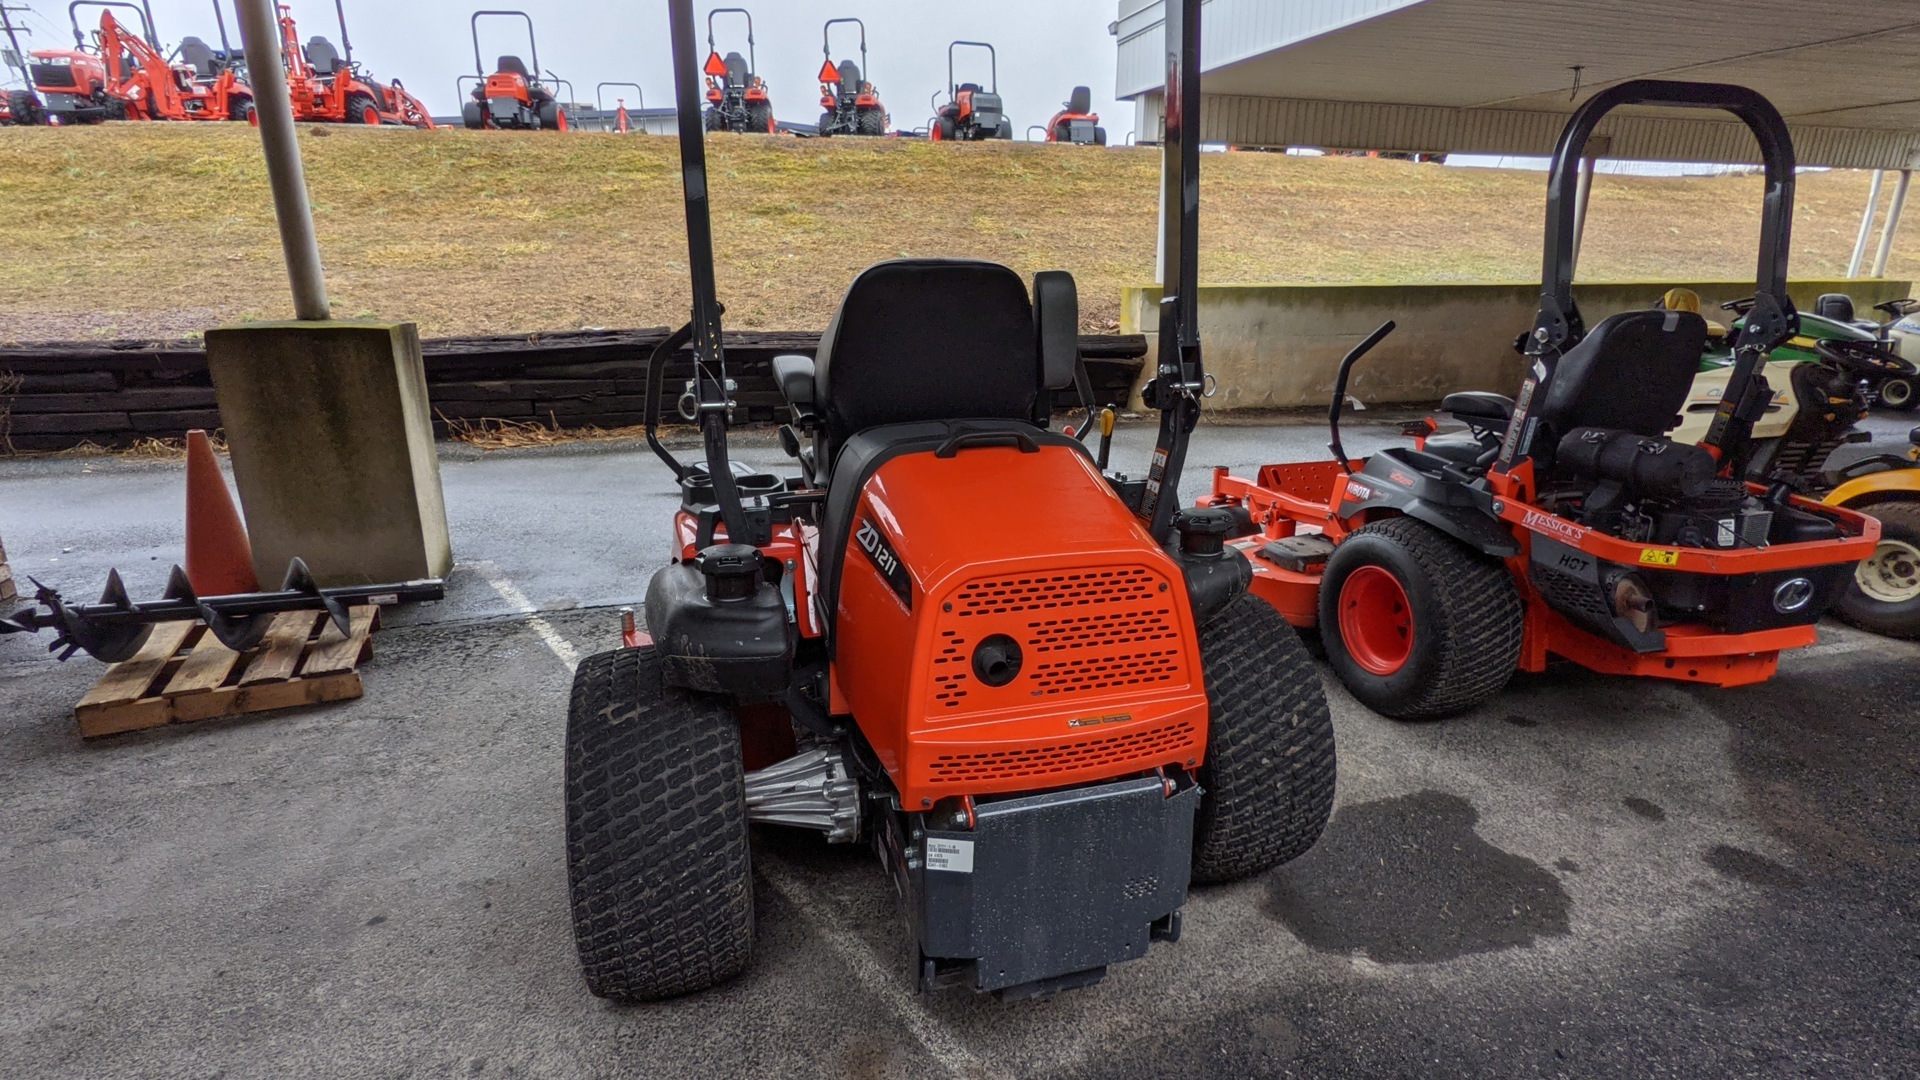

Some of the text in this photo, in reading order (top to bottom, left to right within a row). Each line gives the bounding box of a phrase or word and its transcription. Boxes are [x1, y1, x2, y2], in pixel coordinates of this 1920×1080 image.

[1347, 481, 1370, 500] KUBOTA
[1522, 511, 1584, 539] MESSICK'S
[1559, 554, 1590, 571] HOT
